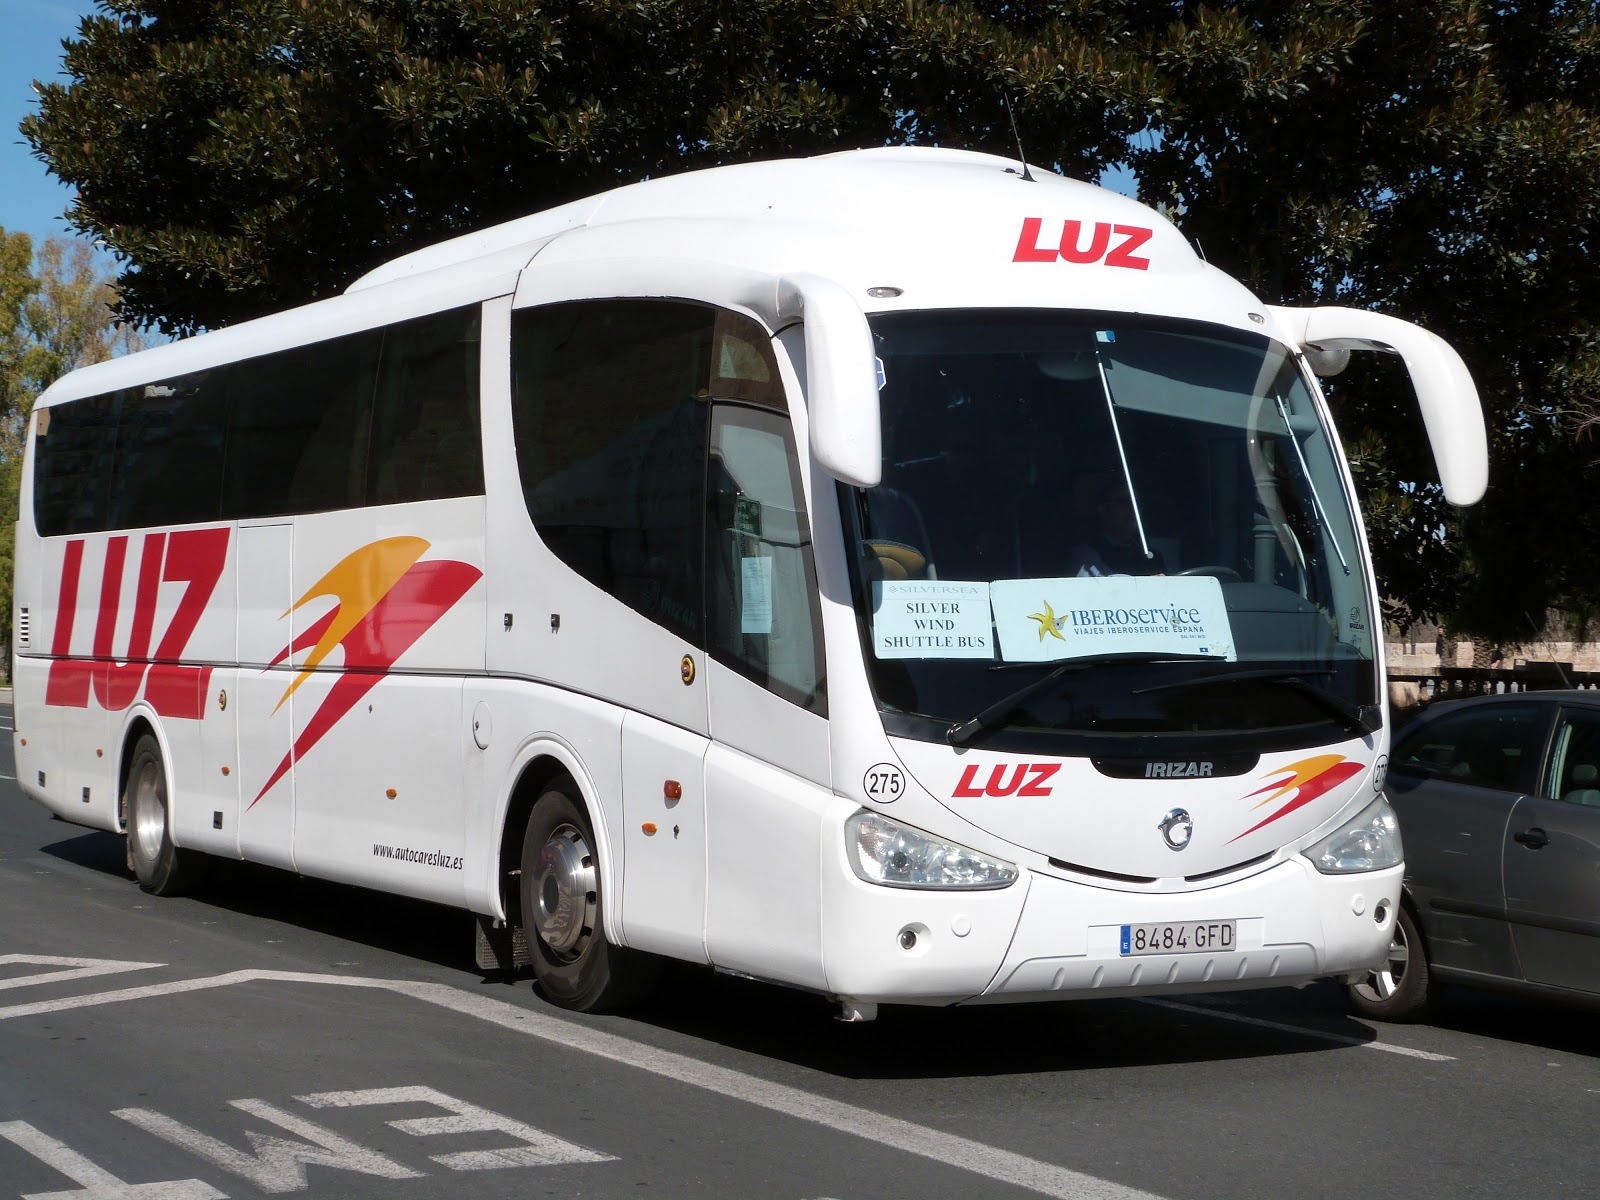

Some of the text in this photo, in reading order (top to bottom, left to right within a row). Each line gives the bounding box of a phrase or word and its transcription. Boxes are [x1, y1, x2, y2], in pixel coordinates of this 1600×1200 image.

[1012, 217, 1153, 271] LUZ
[899, 585, 979, 594] SILVERSEA
[906, 602, 961, 614] SILVER
[1070, 602, 1201, 626] IBEROservice
[45, 527, 232, 720] LUZ
[914, 619, 955, 631] WIND
[1074, 624, 1205, 635] VIAJES IBEROSERVICE ESPAÑA
[884, 635, 985, 648] SHUTTLE BUS
[951, 763, 1062, 798] LUZ
[1144, 761, 1214, 778] IRIZAR
[869, 772, 900, 795] 275
[373, 843, 464, 871] www.autocaresluz.es
[1123, 924, 1232, 951] E 8484 GFD
